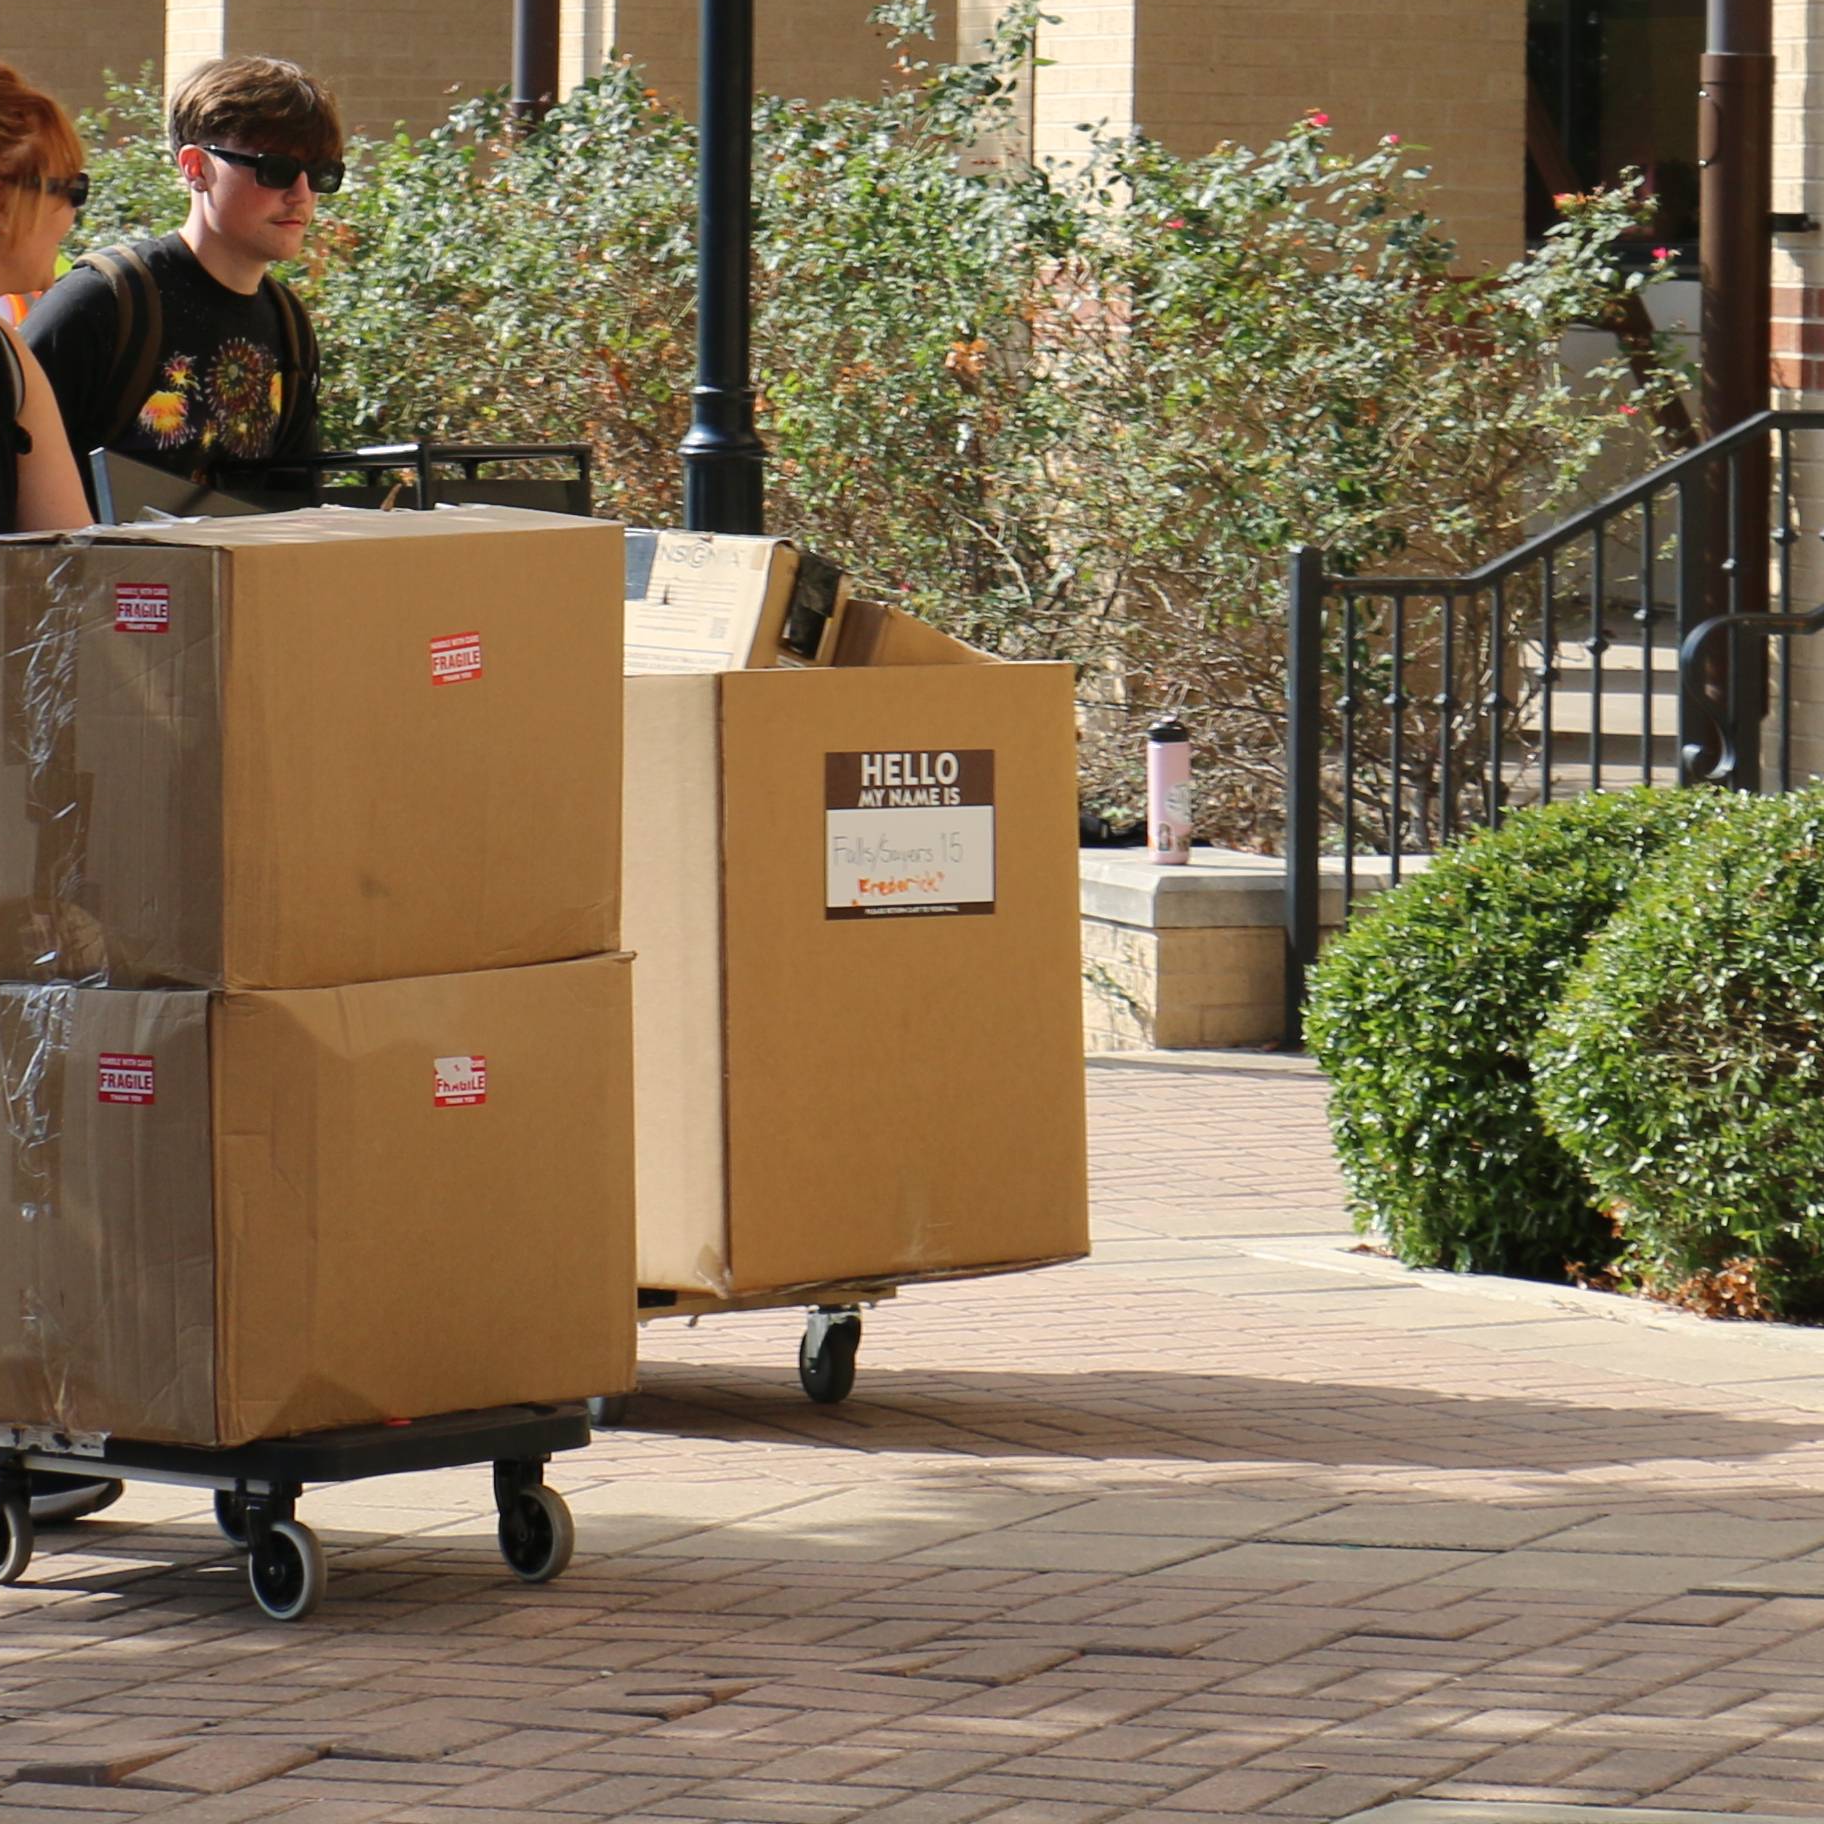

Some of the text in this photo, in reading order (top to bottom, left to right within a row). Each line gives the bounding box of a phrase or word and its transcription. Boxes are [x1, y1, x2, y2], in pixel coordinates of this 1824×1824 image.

[117, 603, 168, 619] FRAGILE
[433, 650, 481, 672] FRAGILE
[860, 751, 960, 787] HELLO
[857, 787, 961, 807] MY NAME IS
[940, 831, 964, 864] 15
[100, 1072, 153, 1090] FRAGILE
